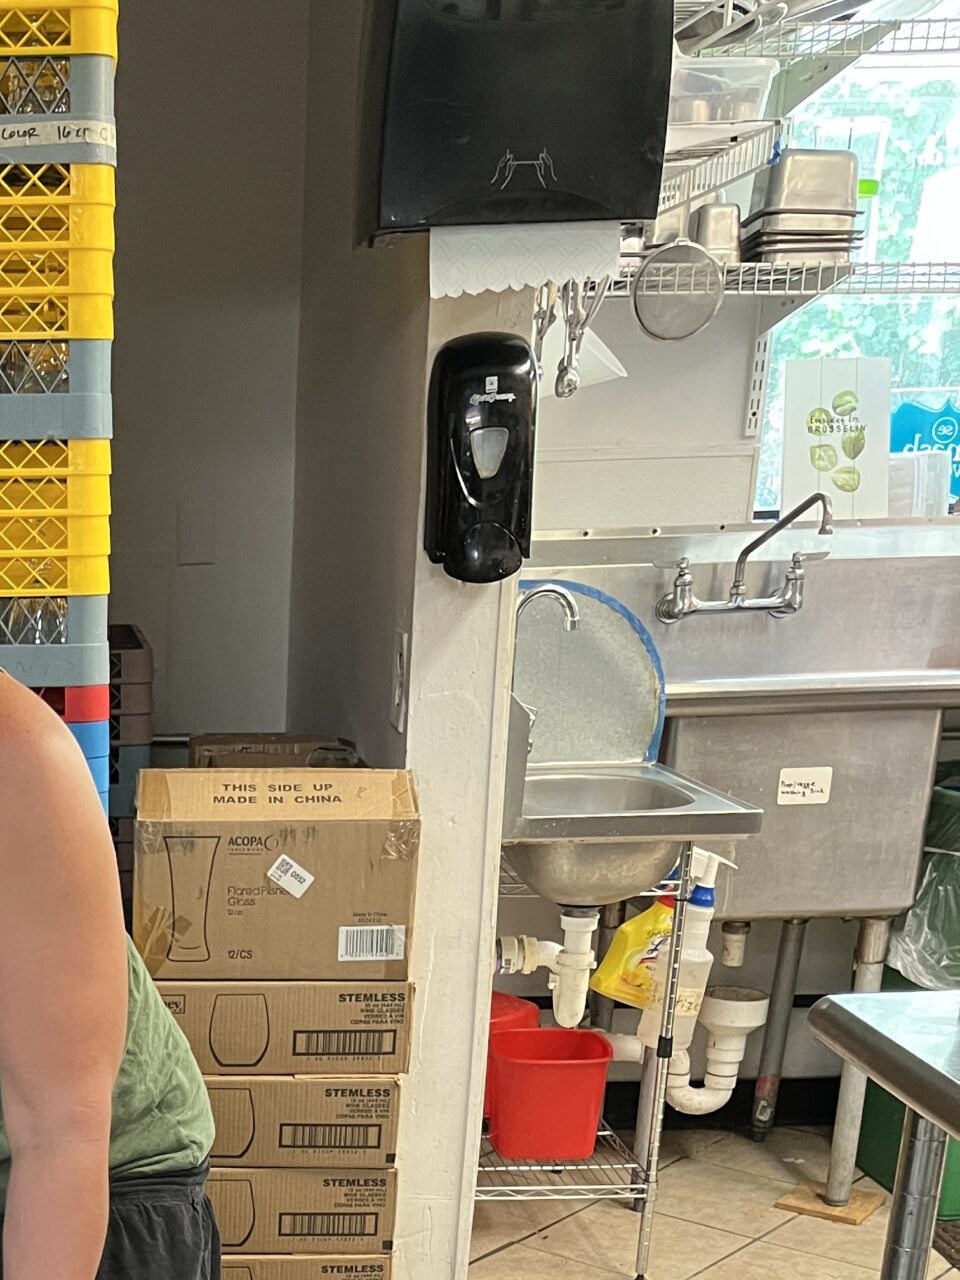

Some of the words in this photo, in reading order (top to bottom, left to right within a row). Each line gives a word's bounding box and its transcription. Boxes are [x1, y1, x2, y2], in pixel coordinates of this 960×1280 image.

[2, 127, 40, 141] COLOR
[57, 125, 71, 141] 16
[222, 783, 257, 792] THIS
[268, 783, 303, 792] SIDE
[313, 783, 333, 791] UP
[213, 796, 258, 804] MADE
[268, 796, 284, 804] IN
[294, 795, 343, 804] CHINA
[227, 836, 263, 847] ACOPA
[227, 886, 260, 896] Flared
[227, 897, 256, 907] Glass
[227, 949, 253, 960] 12/CS
[338, 993, 406, 1002] STEMLESS
[325, 1088, 391, 1098] STEMLESS
[323, 1178, 387, 1187] STEMLESS
[321, 1264, 384, 1274] STEMLESS
